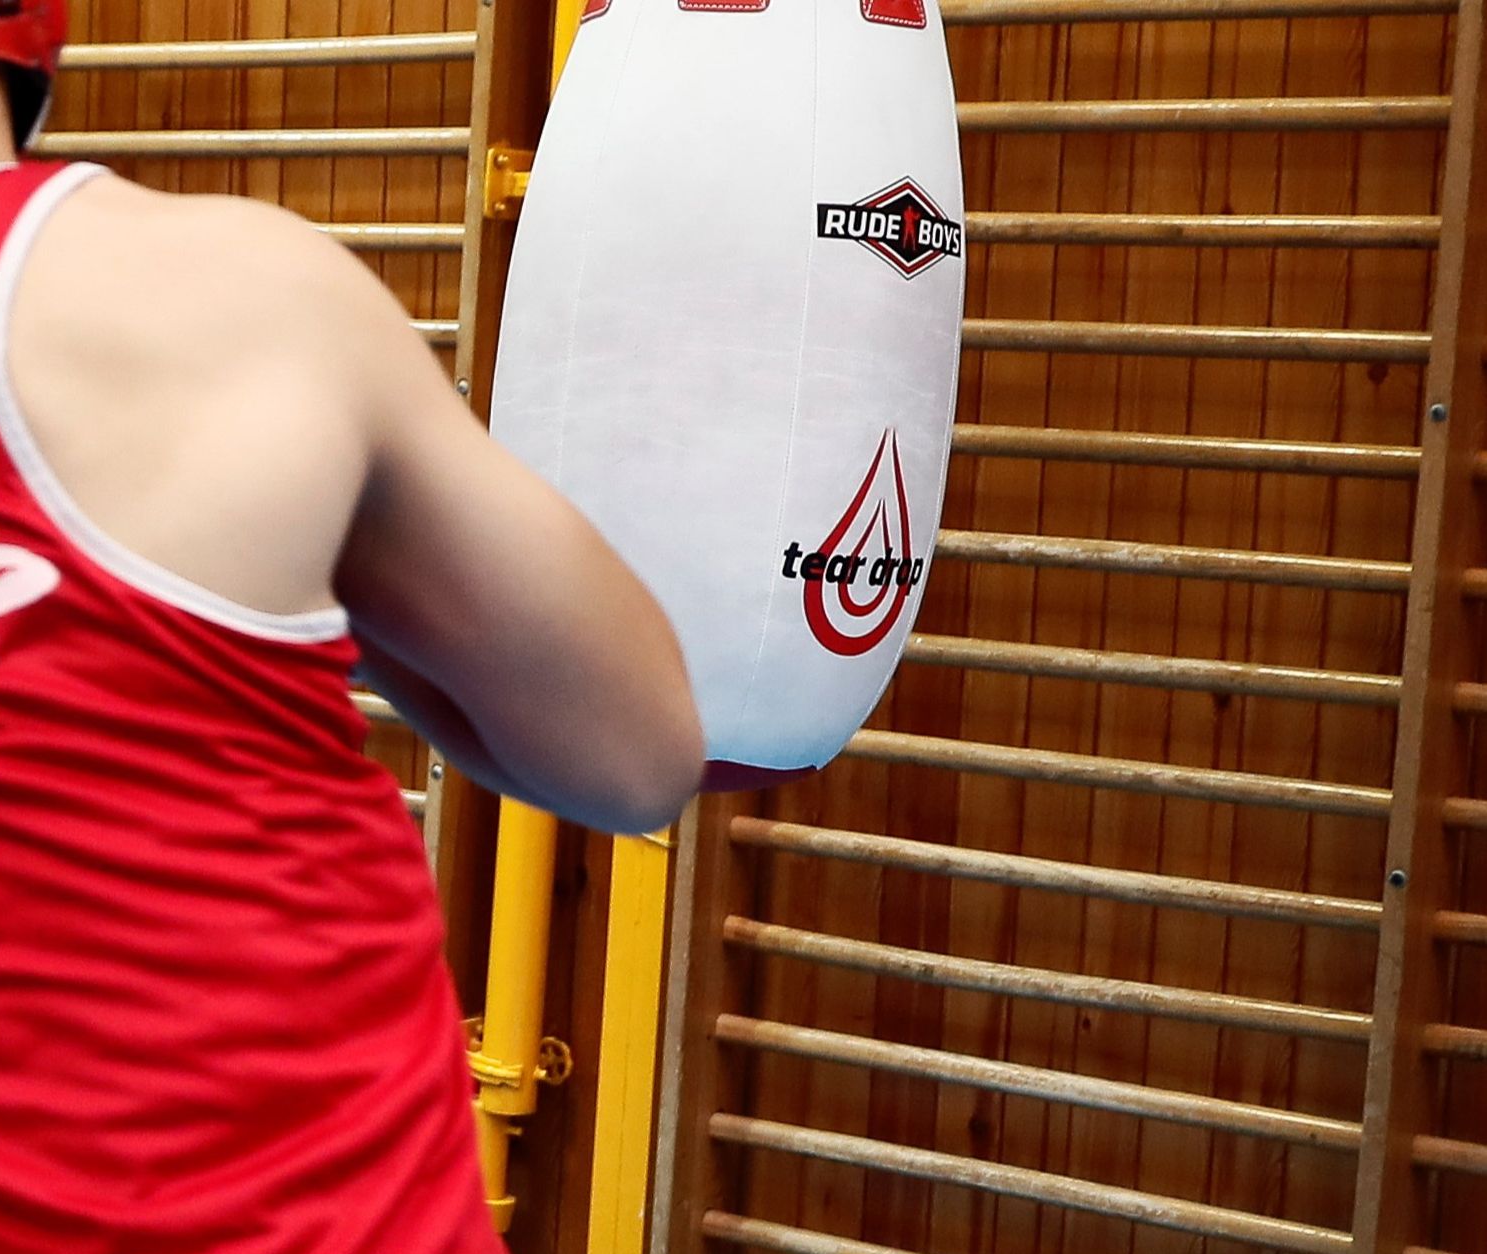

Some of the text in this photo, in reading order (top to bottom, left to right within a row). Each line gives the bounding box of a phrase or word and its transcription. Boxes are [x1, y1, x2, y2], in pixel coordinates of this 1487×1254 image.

[824, 208, 961, 255] RUDE BOYS
[782, 541, 924, 597] tear drop
